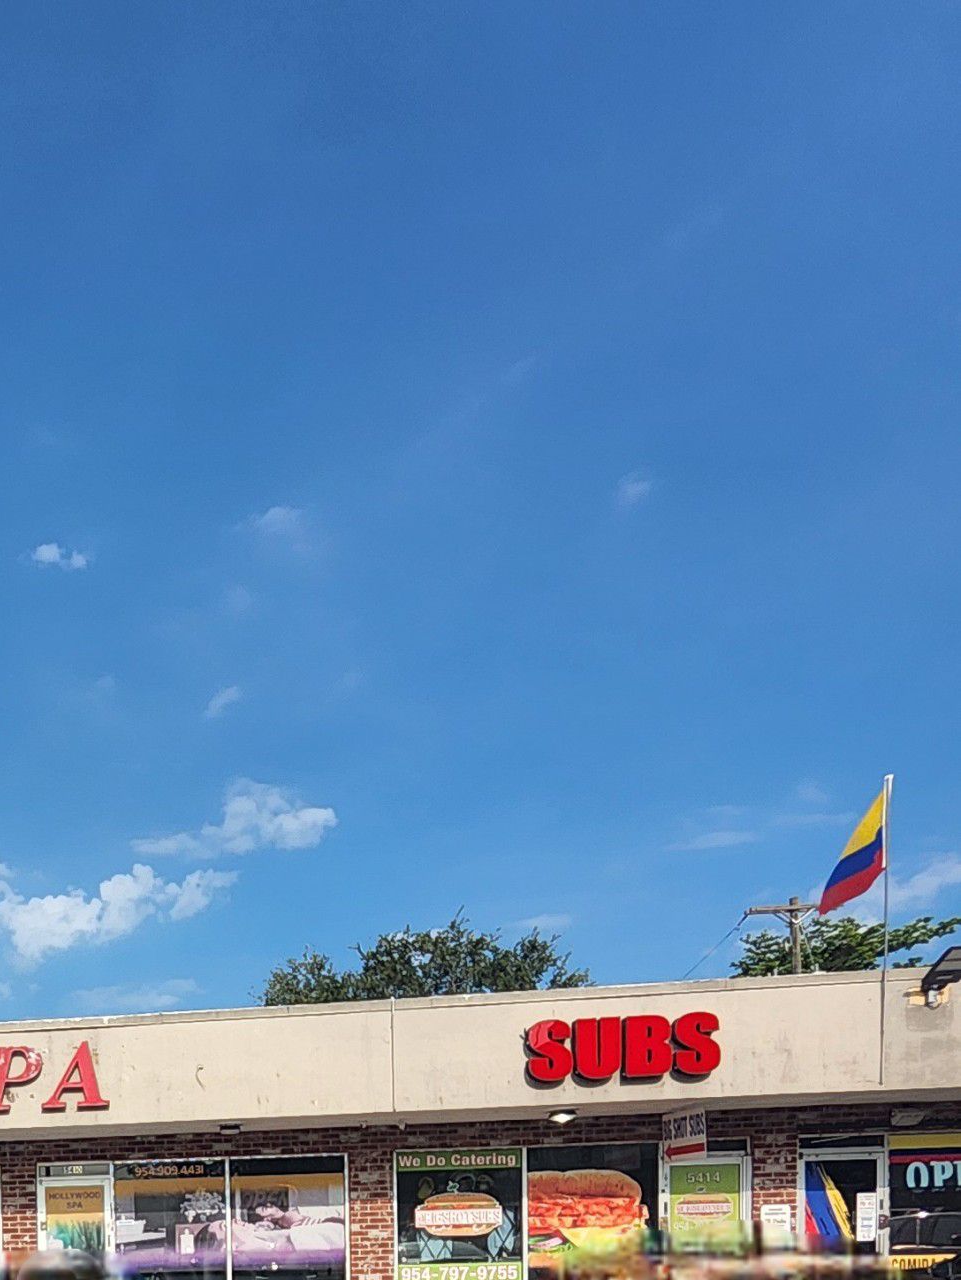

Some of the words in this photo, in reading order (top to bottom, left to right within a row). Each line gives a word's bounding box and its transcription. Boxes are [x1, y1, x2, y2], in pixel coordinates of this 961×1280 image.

[527, 1011, 721, 1082] SUBS
[398, 1155, 421, 1167] We
[426, 1154, 446, 1166] Do
[451, 1152, 516, 1167] Catering
[687, 1172, 720, 1183] 5414
[48, 1191, 102, 1201] HOLLYWOOD
[66, 1201, 84, 1210] SPA
